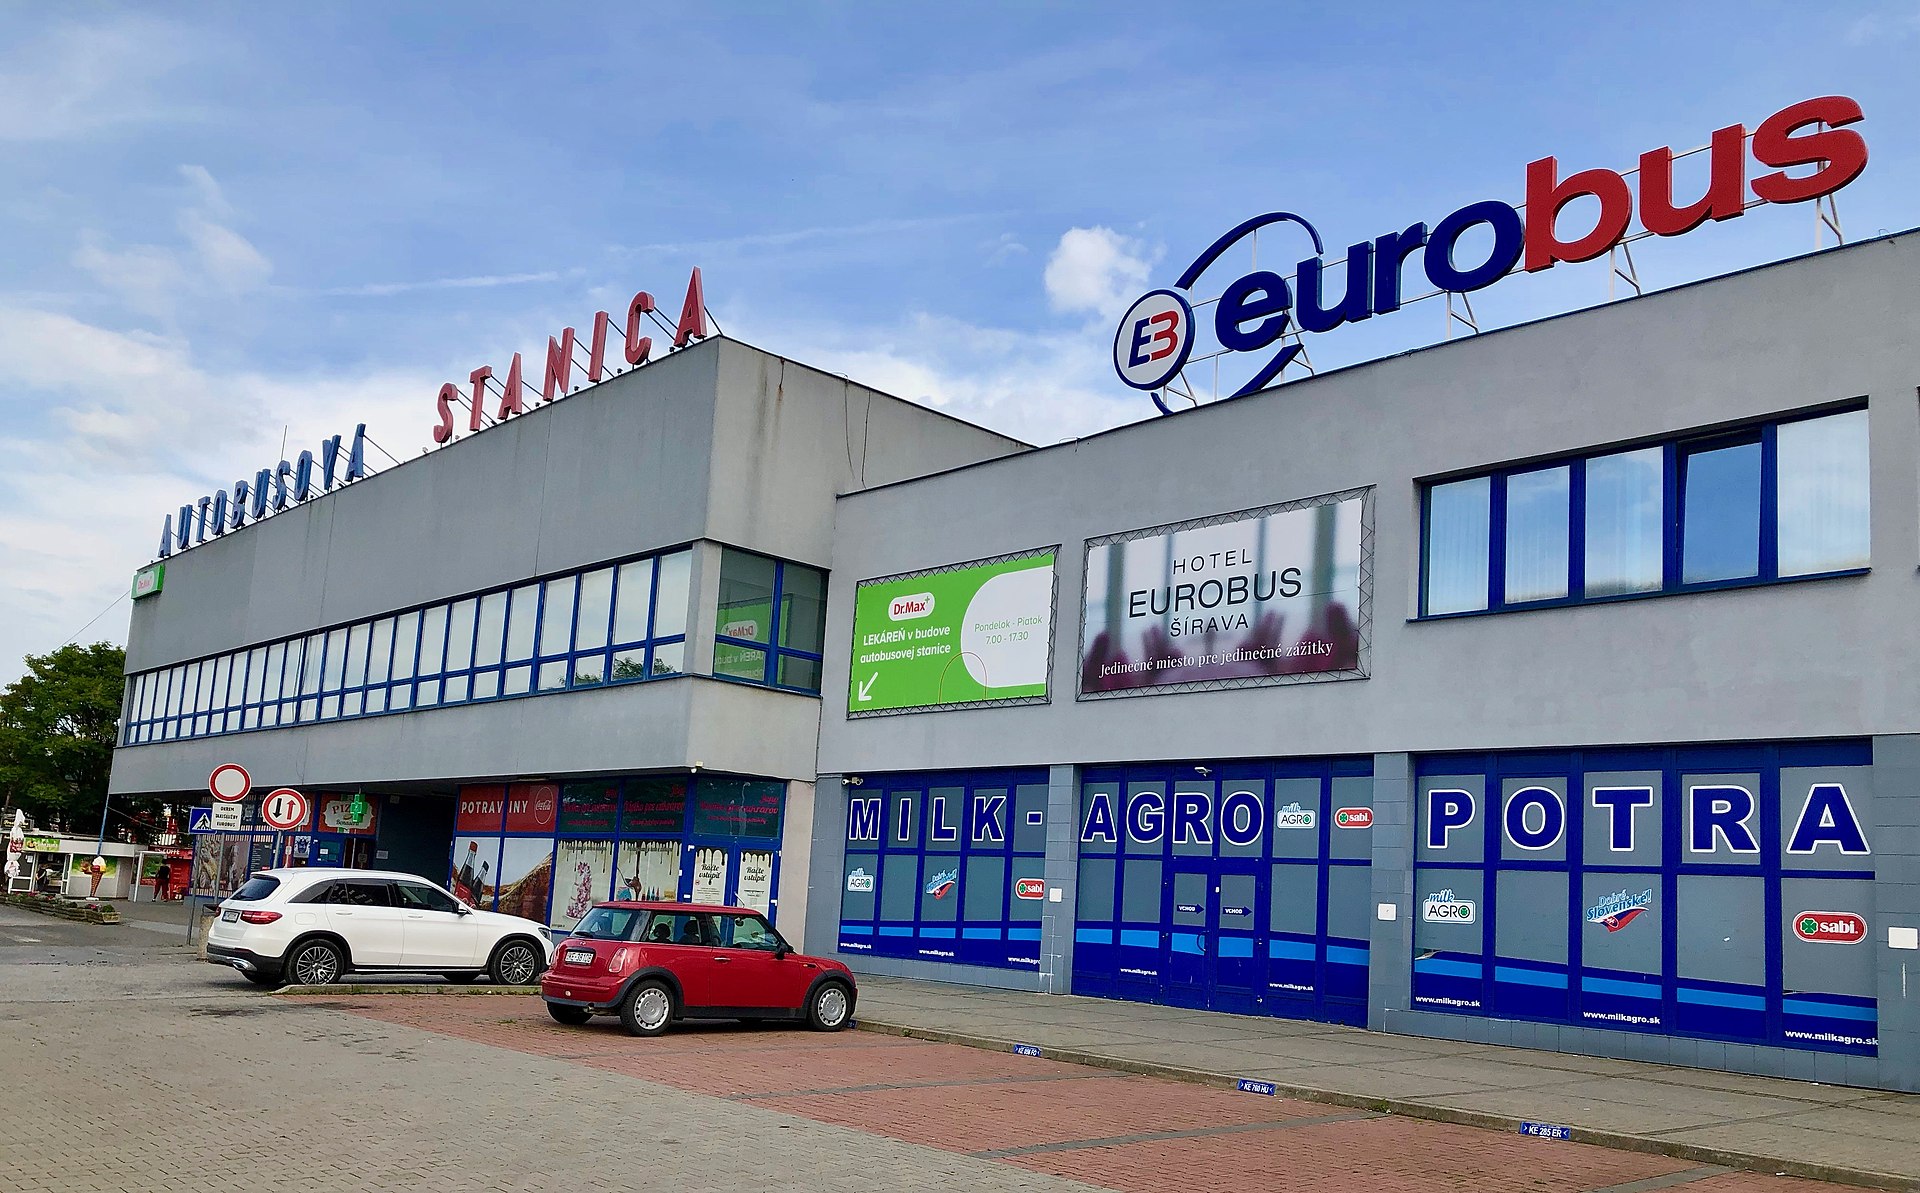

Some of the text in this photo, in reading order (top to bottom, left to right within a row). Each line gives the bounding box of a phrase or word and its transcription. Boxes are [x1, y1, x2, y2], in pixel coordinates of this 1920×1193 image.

[1214, 95, 1869, 352] eurobus
[433, 265, 708, 443] STANICA
[1173, 548, 1253, 575] HOTEL
[1129, 567, 1302, 618] EUROBUS
[893, 601, 926, 615] Dr.Max
[974, 619, 1011, 632] Pondelok
[1017, 616, 1043, 627] Piatok
[1170, 613, 1249, 637] ŠÍRAVA
[863, 626, 951, 646] LEKÁREŇ v budove
[985, 634, 1002, 645] 7.00
[1008, 631, 1029, 642] 17.30
[860, 643, 951, 664] autobusovej stanice
[1099, 640, 1334, 678] Jedinečné miesto pre jedinečné zážitky
[1081, 791, 1264, 846] AGRO
[1426, 782, 1872, 855] POTRA
[1281, 814, 1312, 825] AGRO
[850, 877, 872, 888] AGRO
[1428, 889, 1455, 903] milk
[1428, 904, 1471, 919] AGRO
[1587, 889, 1652, 921] Slovenské!
[1269, 982, 1314, 992] www.milkagro.sk
[1415, 995, 1481, 1008] www.milkagro.sk
[1583, 1011, 1661, 1025] www.milkagro.sk
[1785, 1030, 1879, 1046] www.milkagro.sk
[1243, 1083, 1251, 1091] KE
[1528, 1126, 1539, 1135] KE
[1539, 1127, 1551, 1137] 285
[1552, 1129, 1562, 1138] ER
